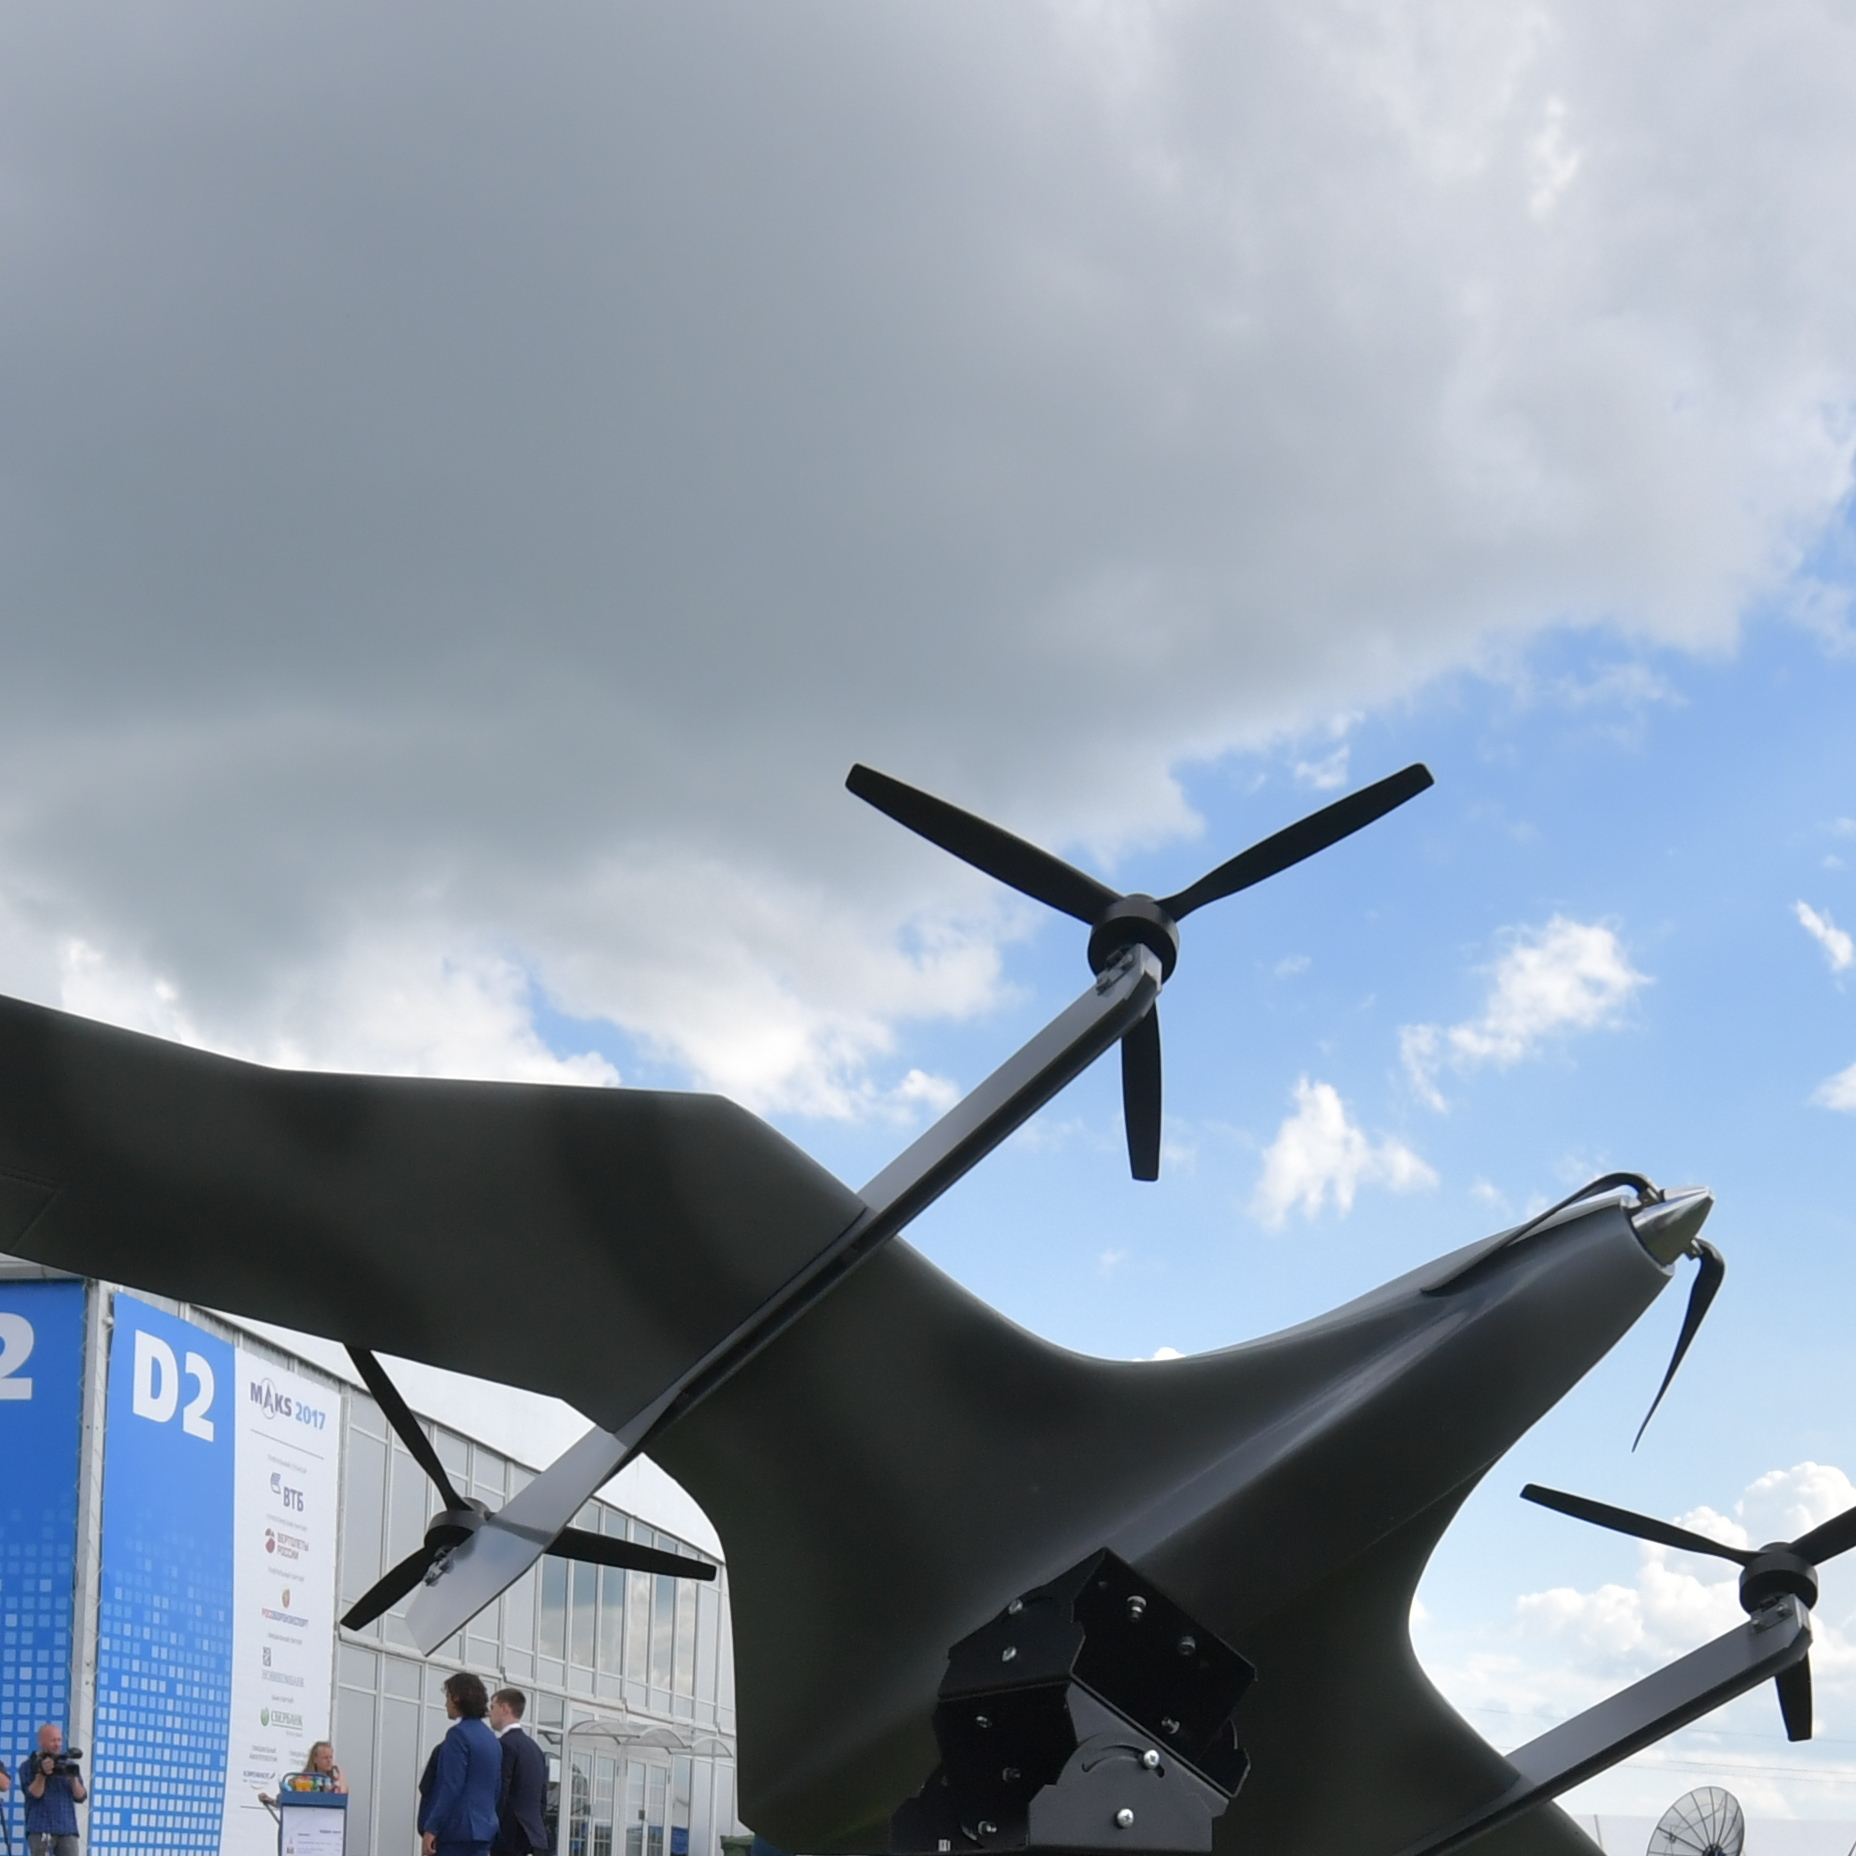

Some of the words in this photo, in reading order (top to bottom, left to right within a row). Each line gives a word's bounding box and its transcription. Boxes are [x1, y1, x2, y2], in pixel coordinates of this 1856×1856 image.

[133, 1328, 216, 1443] D2
[250, 1380, 293, 1418] MAKS
[295, 1401, 326, 1431] 2017
[283, 1487, 304, 1513] ВТБ
